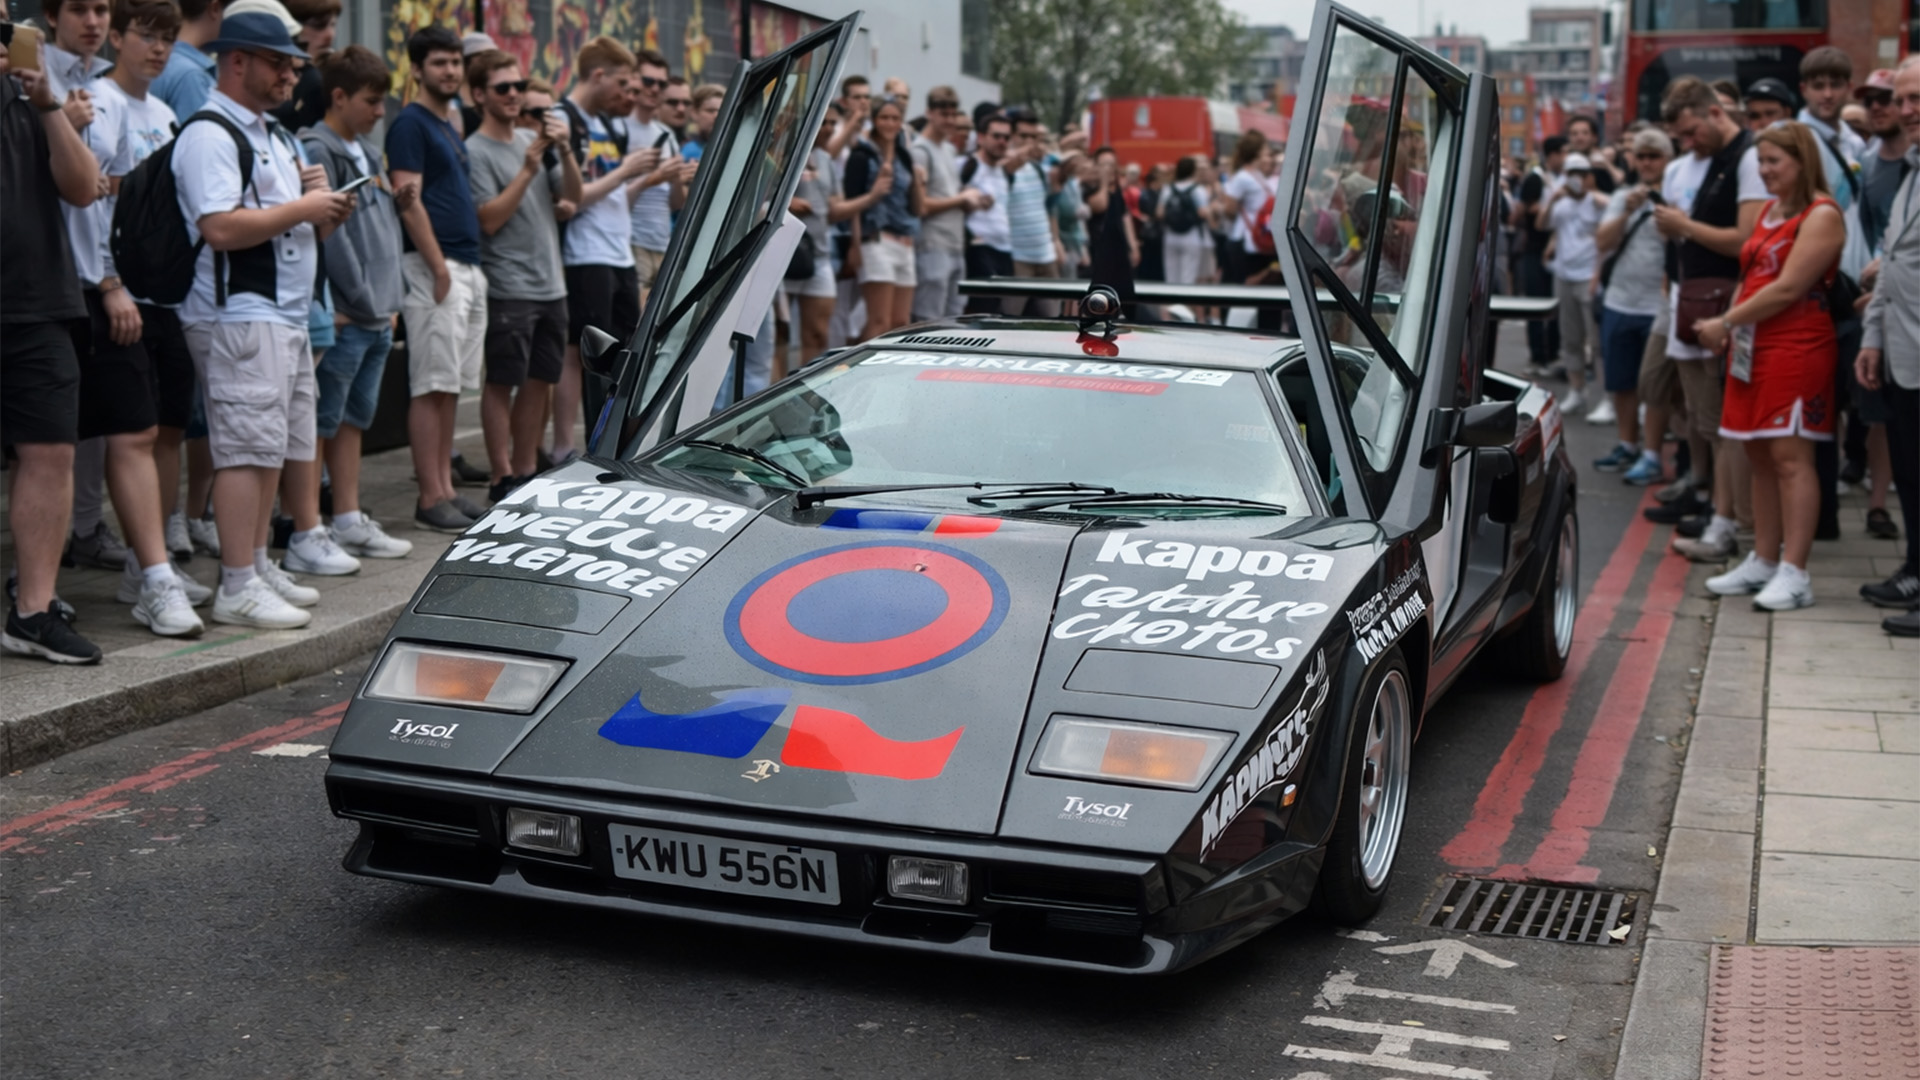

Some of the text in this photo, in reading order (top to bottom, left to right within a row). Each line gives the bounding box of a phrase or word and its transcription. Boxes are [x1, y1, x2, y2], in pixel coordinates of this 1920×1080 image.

[390, 718, 460, 740] Tysol
[1063, 796, 1134, 820] Tysol
[624, 834, 827, 894] KWU 556N
